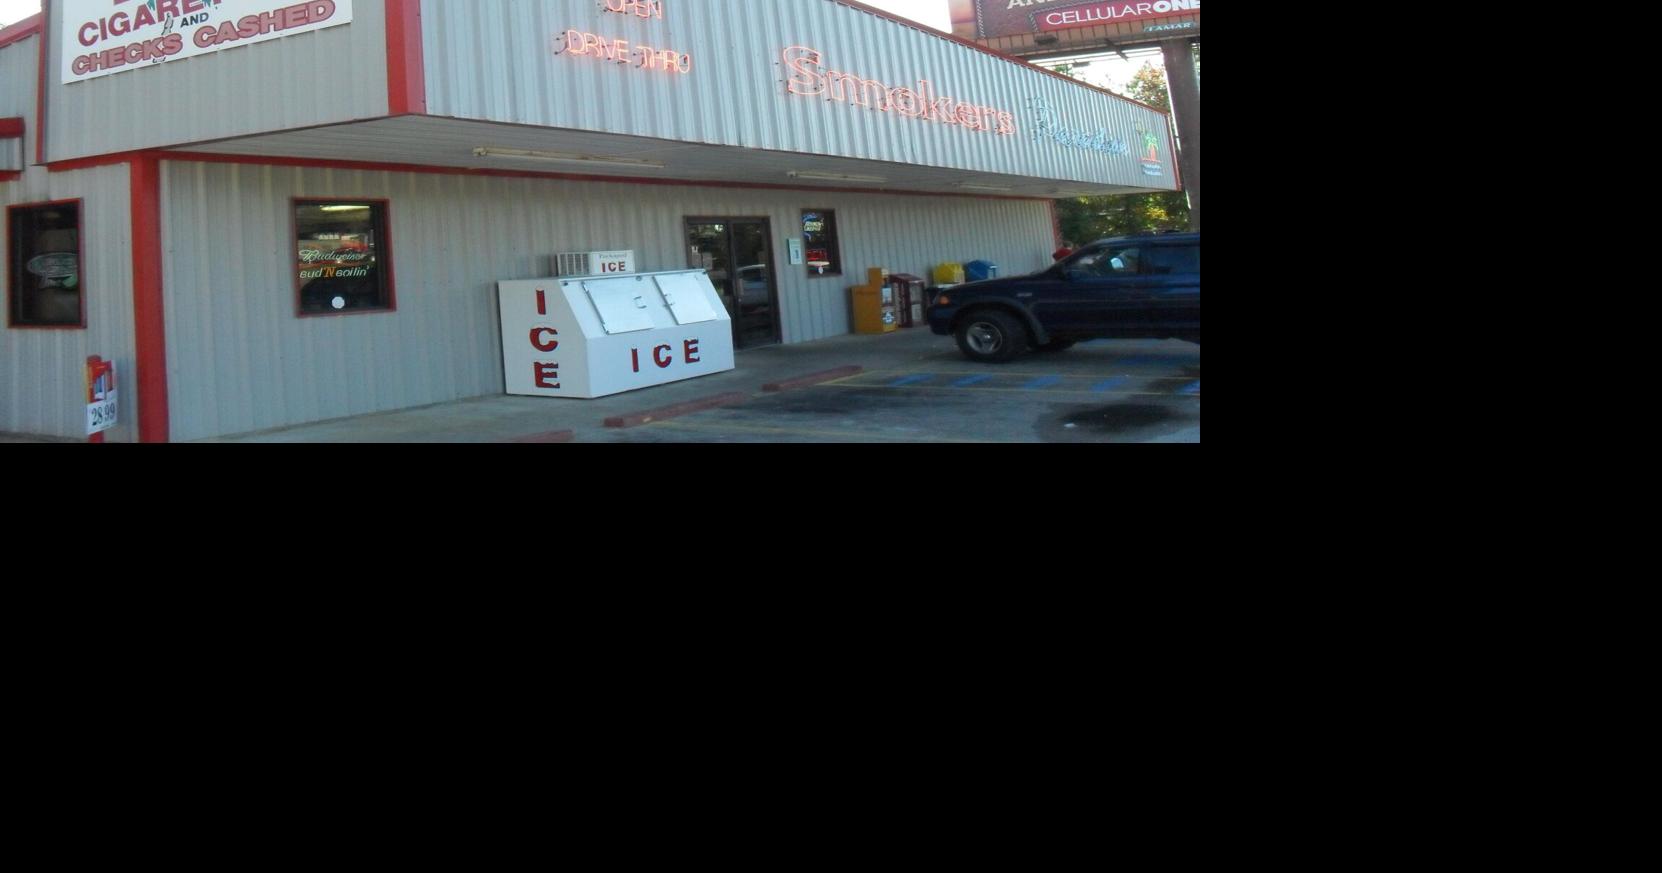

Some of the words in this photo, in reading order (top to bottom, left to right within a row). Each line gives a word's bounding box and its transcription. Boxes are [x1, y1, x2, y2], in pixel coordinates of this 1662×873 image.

[180, 12, 209, 28] AND
[604, 0, 662, 19] OPEN
[71, 33, 183, 76] CHECKS
[193, 0, 336, 48] CASHED
[566, 29, 632, 63] DRIVE
[636, 45, 690, 73] THRU
[783, 46, 1016, 135] Smokers
[299, 249, 367, 264] Budweiser
[601, 261, 626, 273] ICE
[529, 289, 561, 389] ICE
[631, 338, 701, 373] ICE
